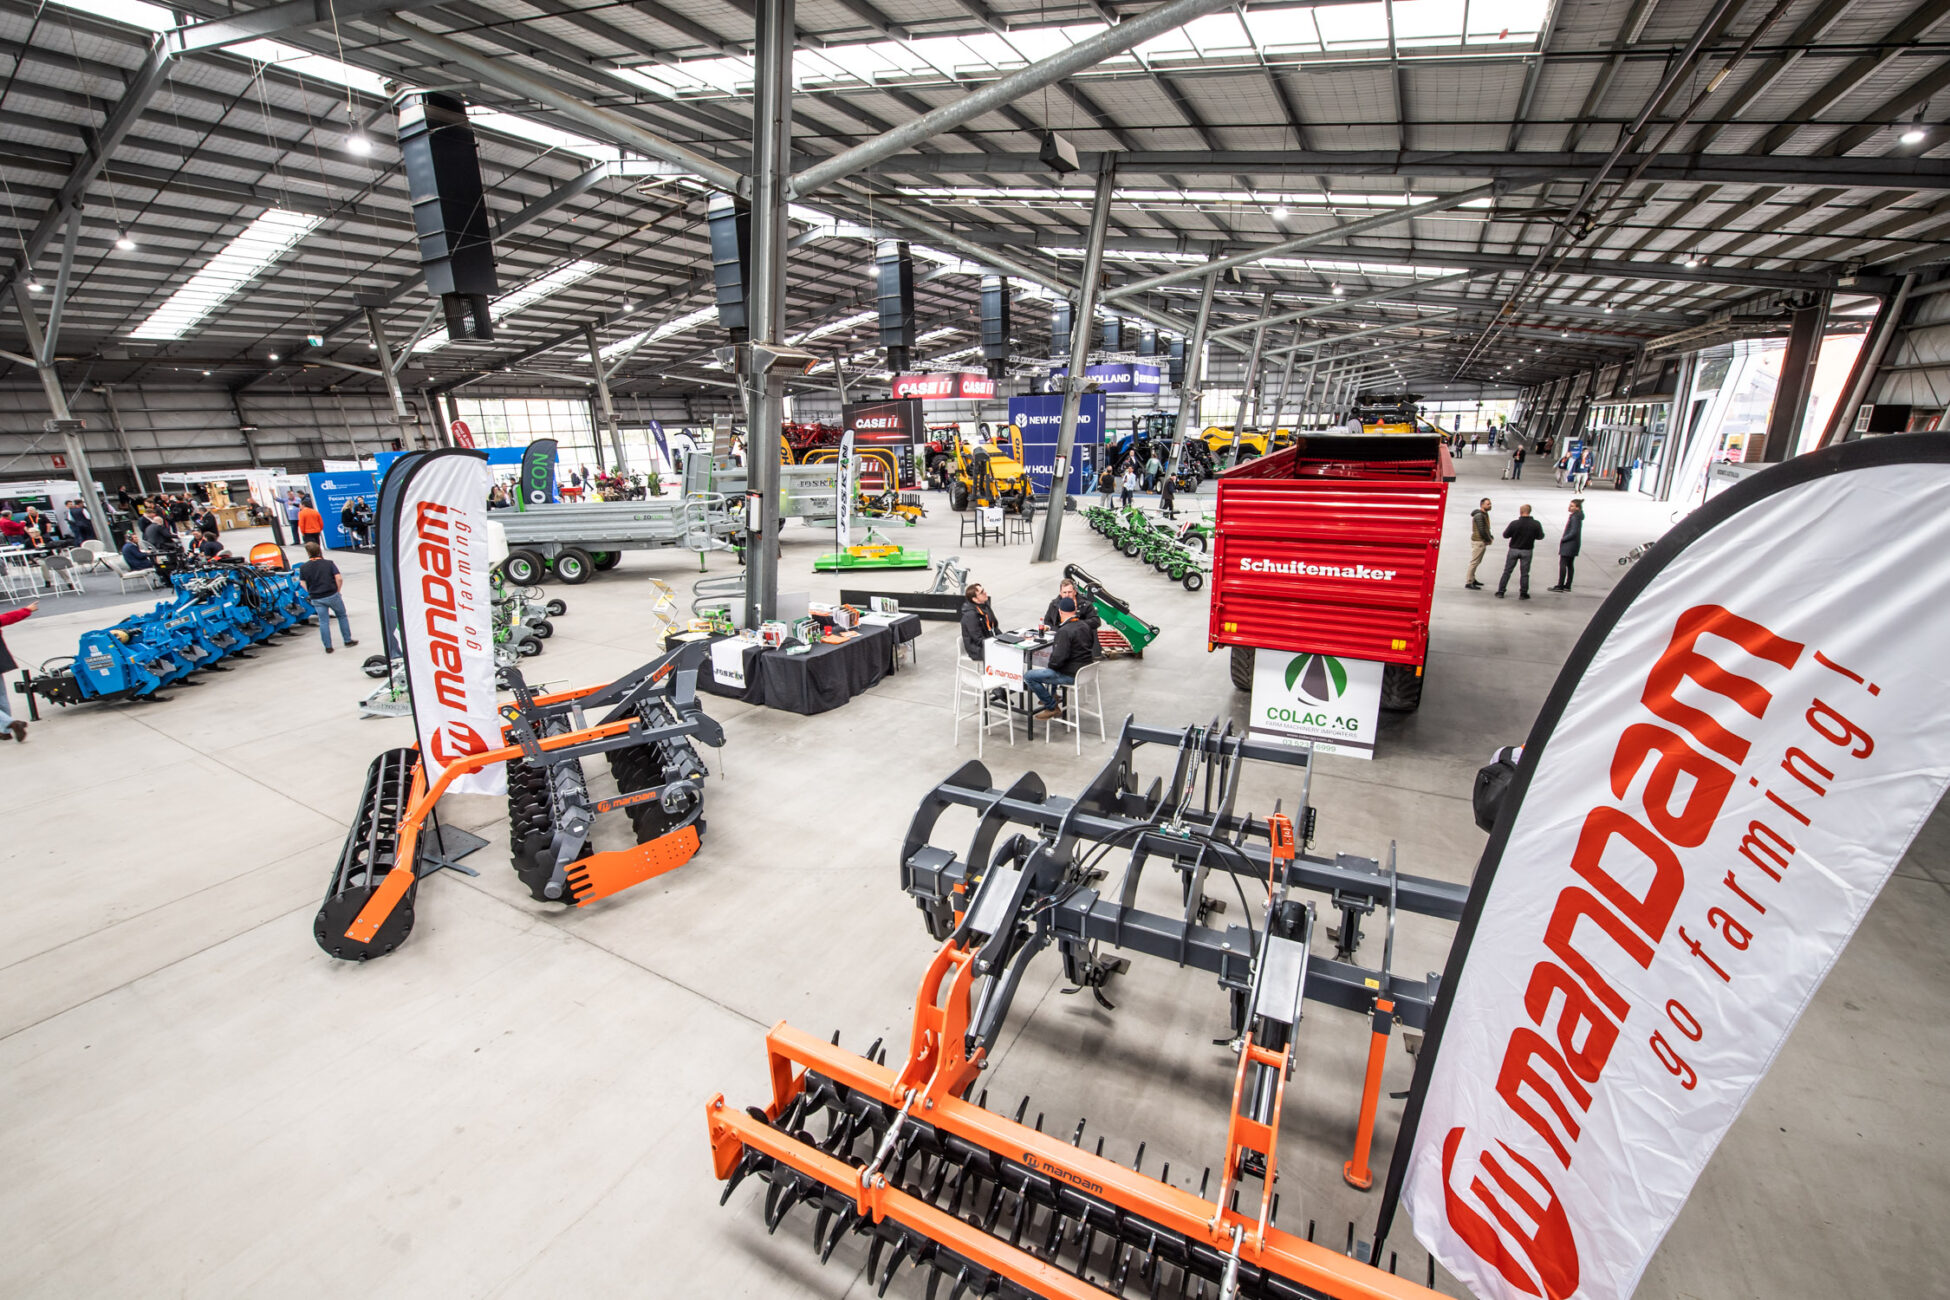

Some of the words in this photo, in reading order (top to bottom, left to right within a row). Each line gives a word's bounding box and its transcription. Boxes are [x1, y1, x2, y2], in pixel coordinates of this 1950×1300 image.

[898, 382, 938, 395] CASE
[963, 380, 986, 394] CASE
[855, 418, 886, 429] CASE
[1029, 416, 1048, 425] NEW
[1049, 415, 1091, 424] HOND
[781, 447, 791, 465] HO
[530, 453, 548, 504] OCON
[1032, 465, 1074, 474] HOLLD
[799, 477, 836, 488] JOSKI
[450, 506, 475, 612] farming!
[1239, 557, 1397, 581] Schuitemaker
[466, 626, 482, 651] go
[1266, 706, 1328, 727] COLAC
[1265, 720, 1283, 728] FARM
[1283, 723, 1320, 733] MACHINERY
[1320, 729, 1358, 738] IMPORTERS
[1676, 649, 1883, 984] farming!
[1649, 997, 1704, 1092] go
